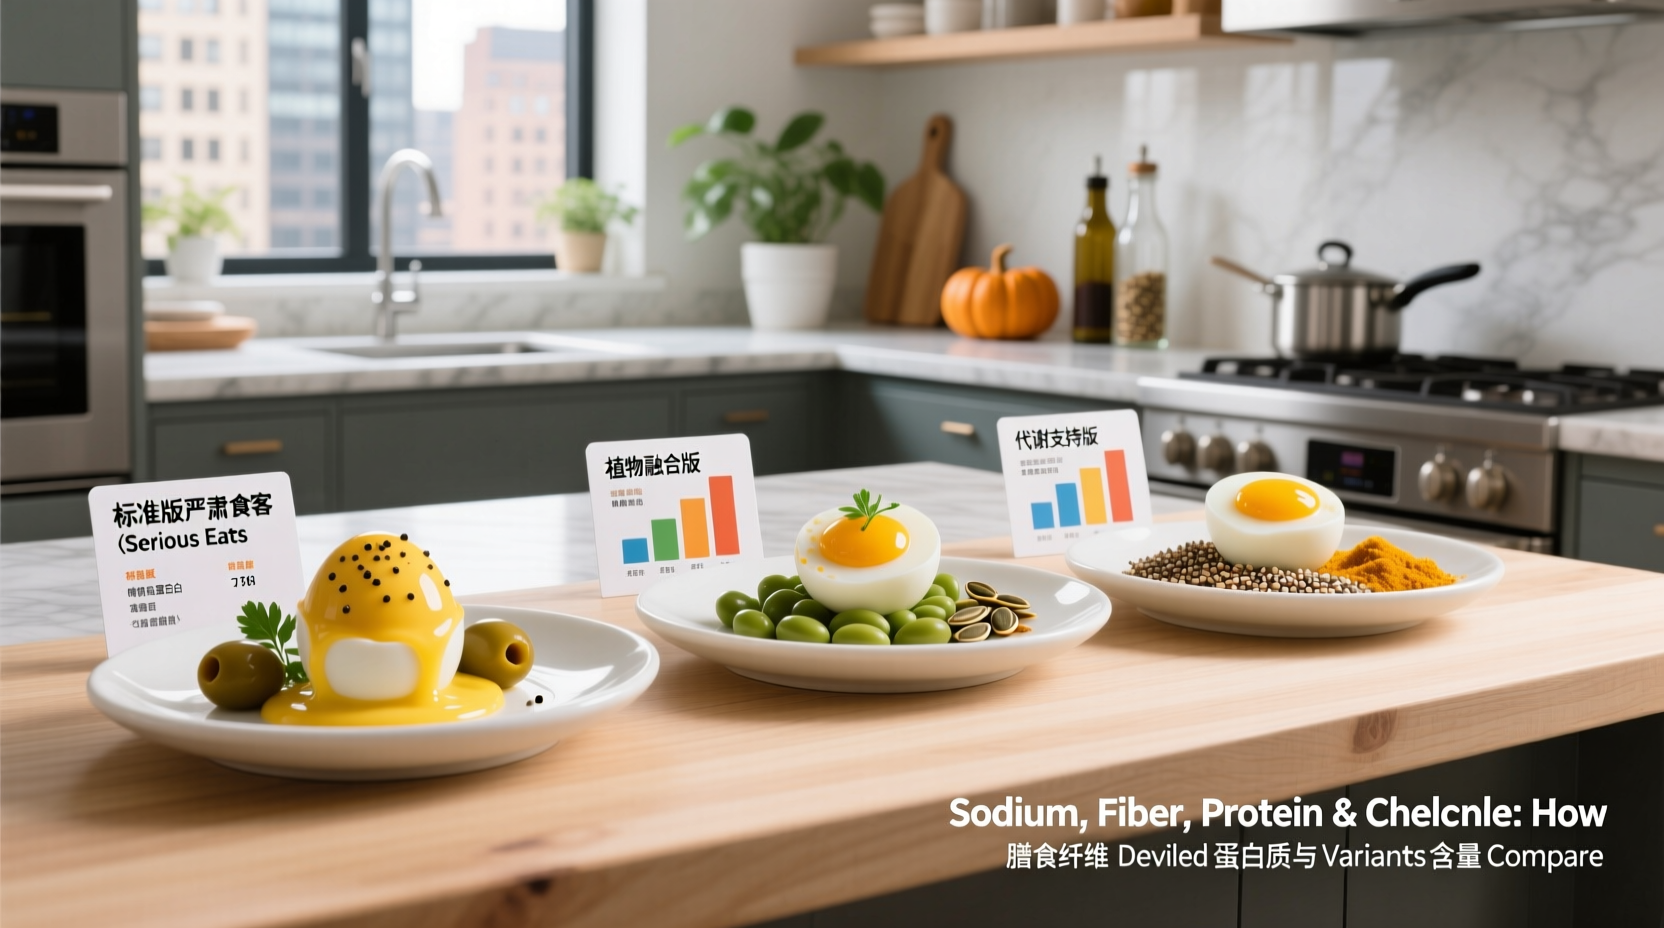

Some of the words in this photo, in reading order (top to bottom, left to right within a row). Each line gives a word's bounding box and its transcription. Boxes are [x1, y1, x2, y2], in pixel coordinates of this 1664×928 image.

[604, 451, 701, 480] 植物融合版
[112, 491, 273, 528] 标准版严肃食客
[118, 531, 200, 554] (Serious
[204, 527, 248, 546] Eats
